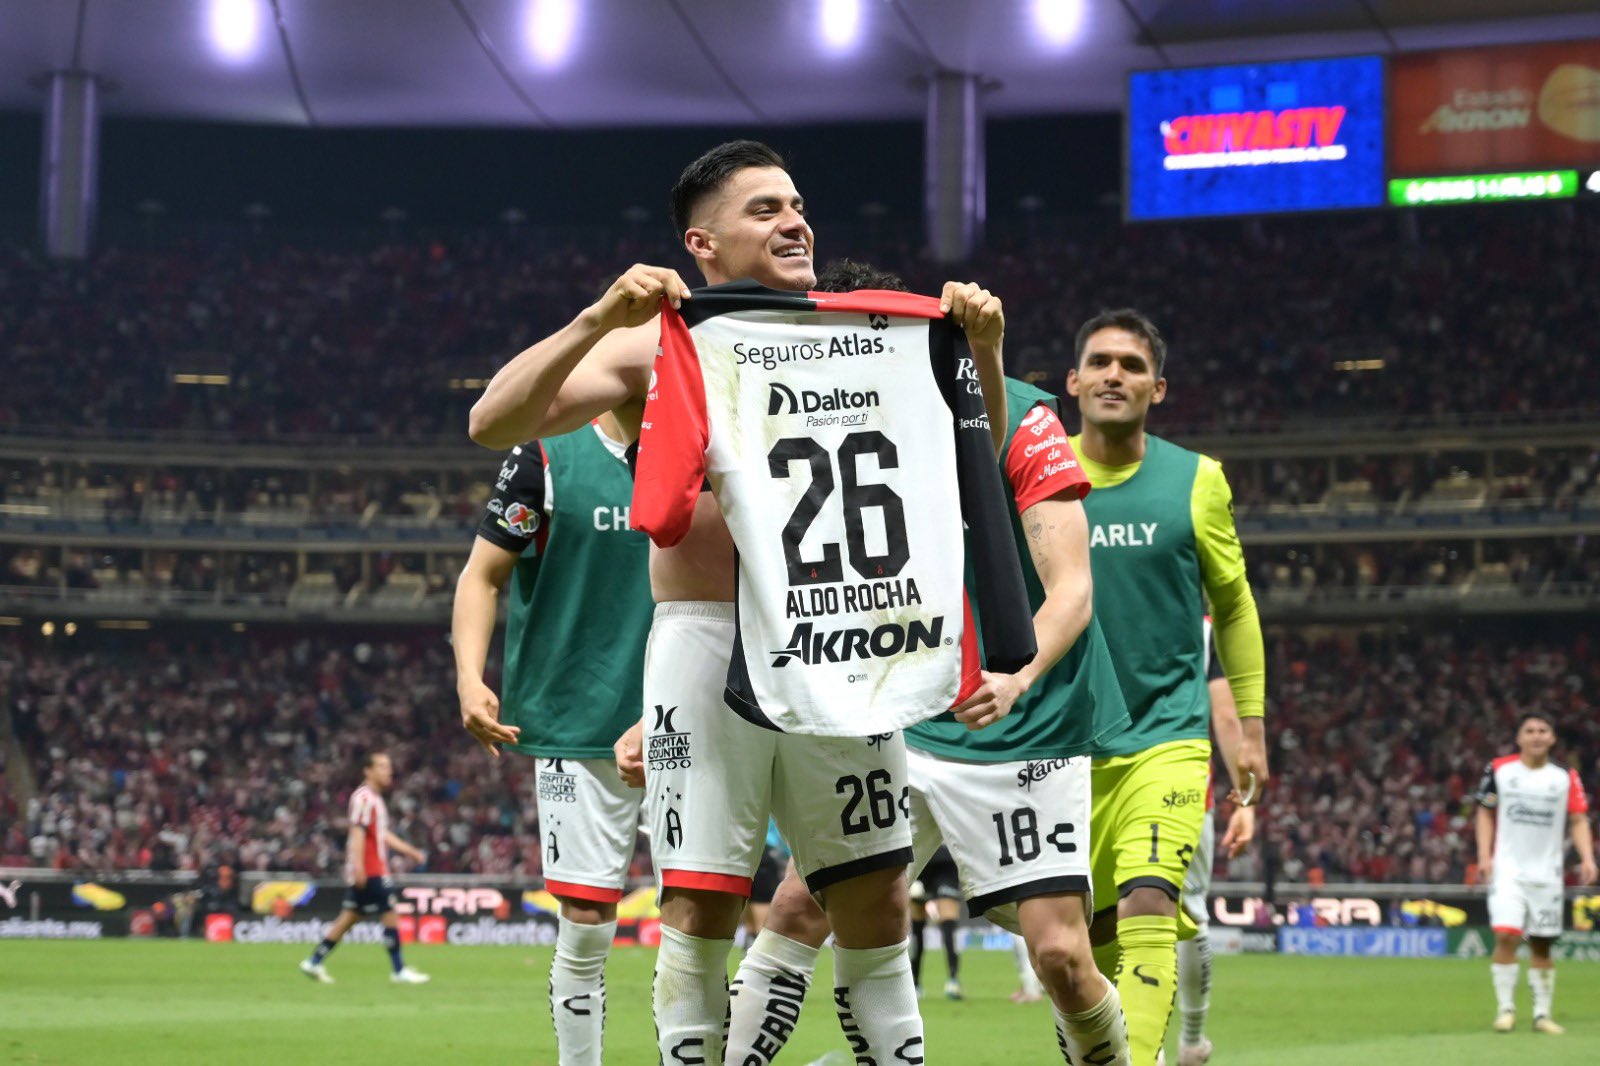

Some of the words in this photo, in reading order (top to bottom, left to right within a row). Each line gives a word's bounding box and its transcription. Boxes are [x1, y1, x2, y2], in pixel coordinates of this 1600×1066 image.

[733, 342, 824, 371] Seguros
[828, 333, 885, 359] Atlas
[956, 357, 979, 381] Re
[801, 388, 880, 414] Dalton
[806, 415, 839, 427] Pasión
[841, 414, 858, 427] por
[1048, 447, 1061, 461] de
[767, 430, 911, 587] 26
[1089, 522, 1159, 548] ARLY
[786, 588, 839, 619] ALDO
[843, 578, 922, 614] ROCHA
[769, 615, 945, 668] AKRON
[648, 746, 690, 760] COUNTRY
[835, 768, 897, 836] 26
[992, 806, 1041, 867] 18
[1148, 823, 1160, 863] 1
